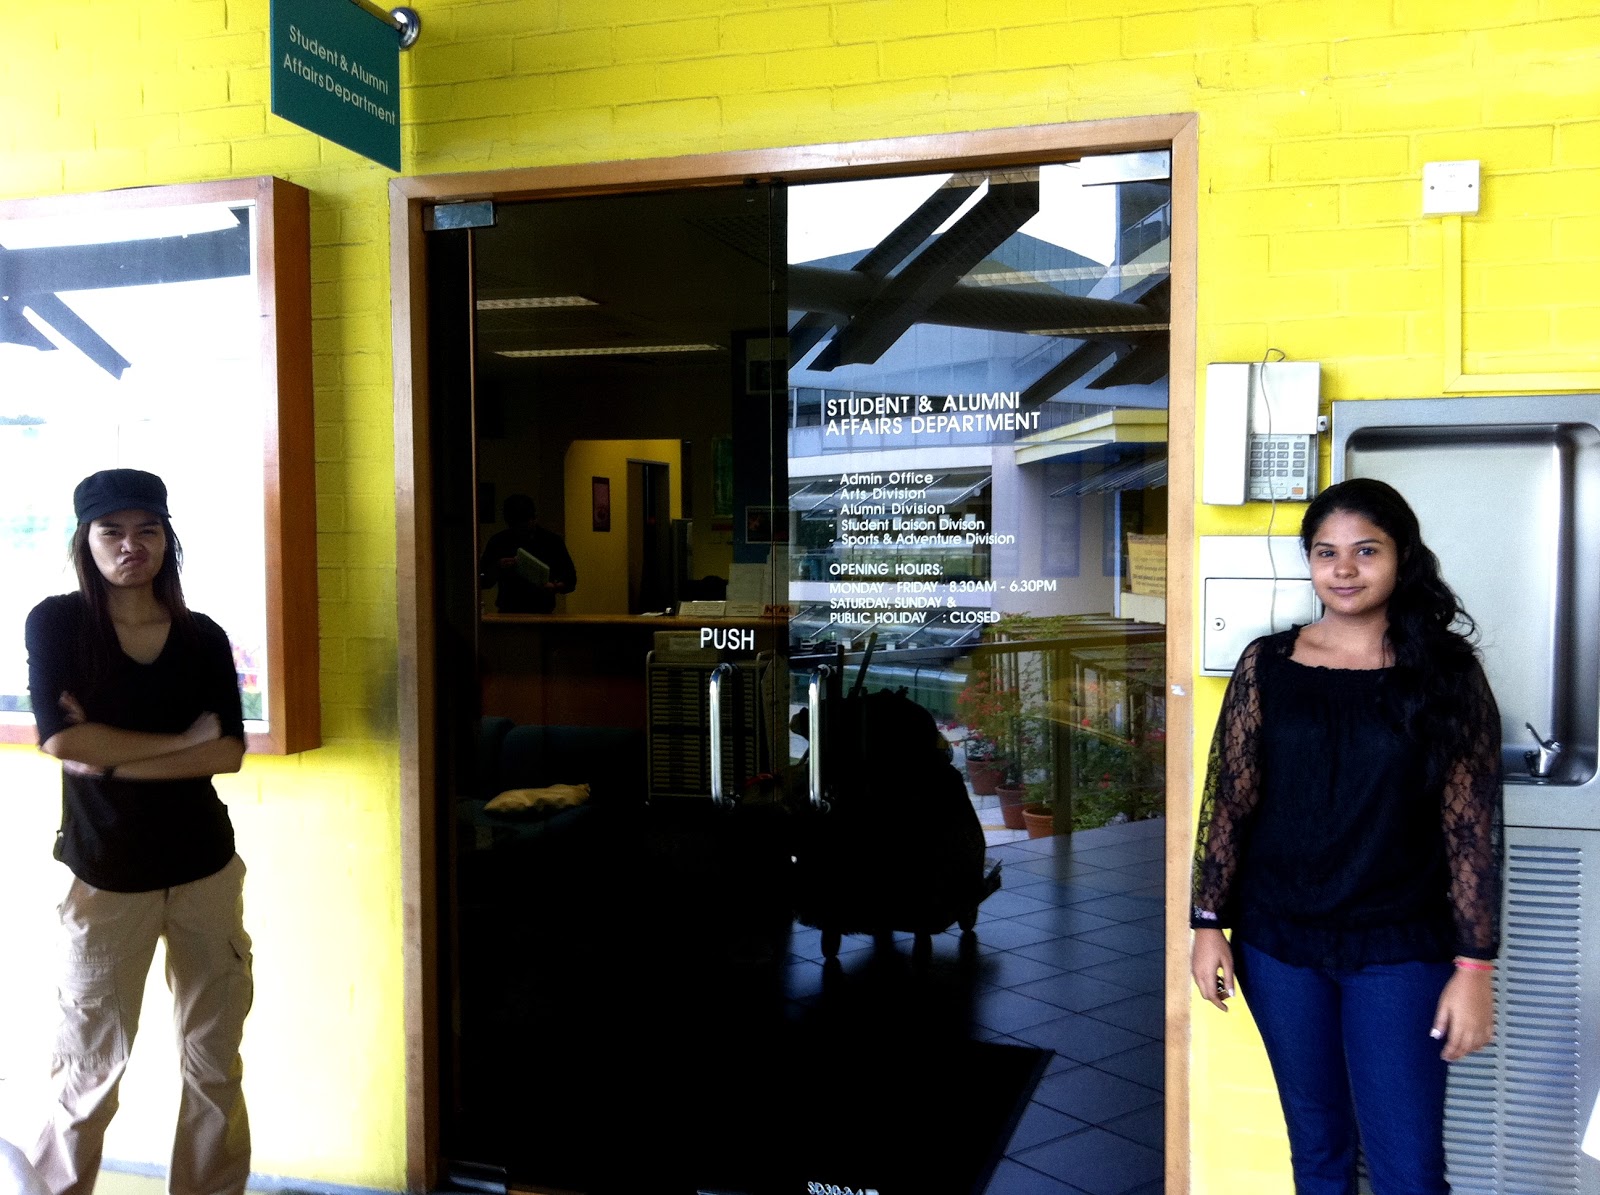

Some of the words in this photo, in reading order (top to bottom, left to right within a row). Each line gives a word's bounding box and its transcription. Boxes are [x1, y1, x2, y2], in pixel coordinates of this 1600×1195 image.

[289, 24, 338, 67] Student
[340, 55, 349, 72] &
[351, 61, 389, 95] Alumni
[283, 53, 324, 88] Affairs
[325, 74, 396, 126] Department
[826, 396, 910, 417] STUDENT
[918, 395, 933, 413] &
[942, 391, 1020, 412] ALUMNI
[825, 417, 903, 436] AFFAIRS
[911, 411, 1041, 434] DEPARTMENT
[840, 473, 882, 485] Admin
[888, 472, 933, 485] Office
[840, 488, 866, 500] Arts
[872, 487, 926, 500] Division
[840, 503, 885, 515] Alumni
[891, 502, 945, 515] Division
[841, 519, 889, 531] Student
[892, 518, 936, 531] Liaison
[939, 518, 985, 531] Divison
[841, 534, 879, 547] Sports
[882, 533, 893, 545] &
[895, 533, 962, 545] Adventure
[965, 533, 1015, 545] Division
[829, 563, 889, 576] OPENING
[895, 563, 943, 576] HOURS:
[829, 581, 884, 594] MONDAY
[896, 581, 937, 593] FRIDAY
[949, 580, 997, 593] 8.30AM
[1009, 580, 1057, 592] 6.30PM
[830, 597, 891, 610] SATURDAY,
[894, 596, 942, 609] SUNDAY
[946, 597, 957, 608] &
[830, 612, 871, 624] PUBLIC
[874, 611, 927, 624] HOLIDAY
[949, 611, 1000, 623] CLOSED
[700, 627, 755, 650] PUSH
